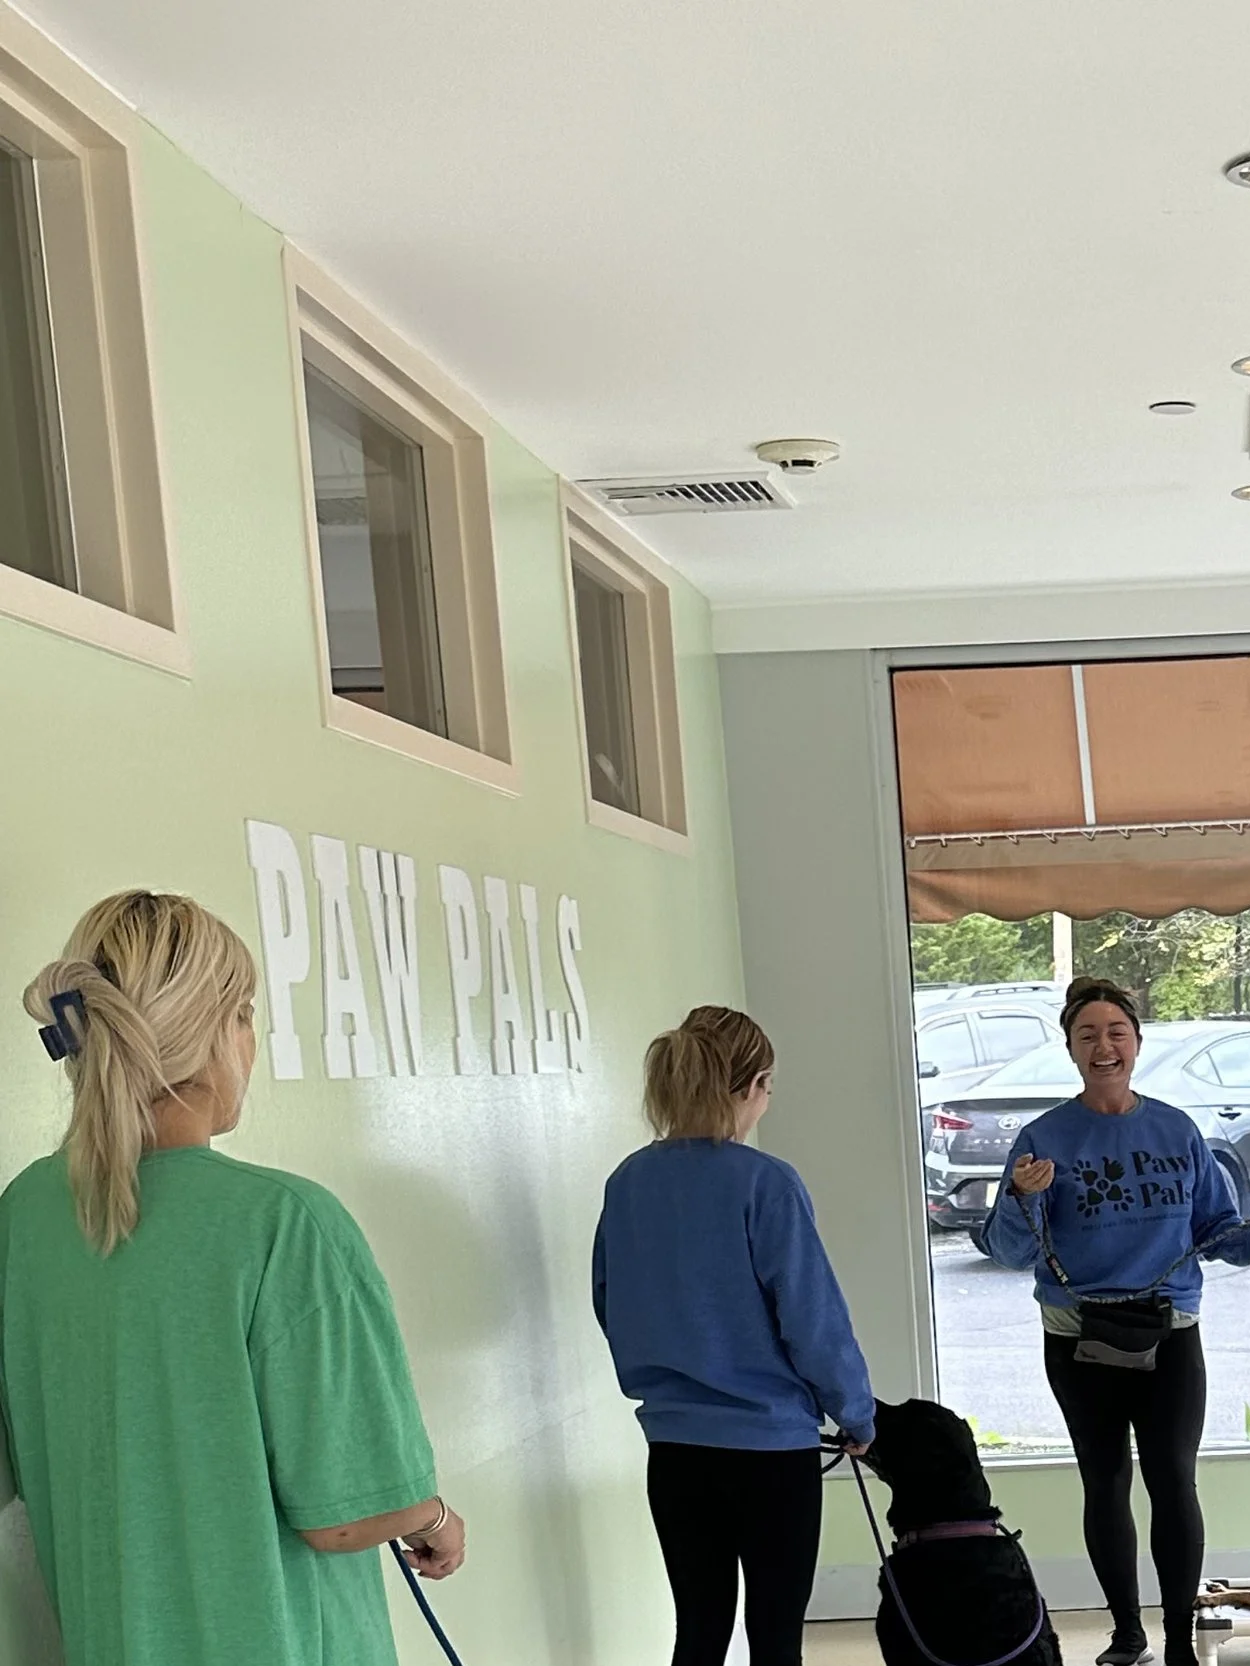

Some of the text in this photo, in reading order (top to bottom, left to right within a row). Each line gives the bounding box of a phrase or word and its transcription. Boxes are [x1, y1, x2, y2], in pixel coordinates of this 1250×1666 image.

[245, 818, 590, 1080] PAW PALS
[1129, 1150, 1189, 1176] Paw
